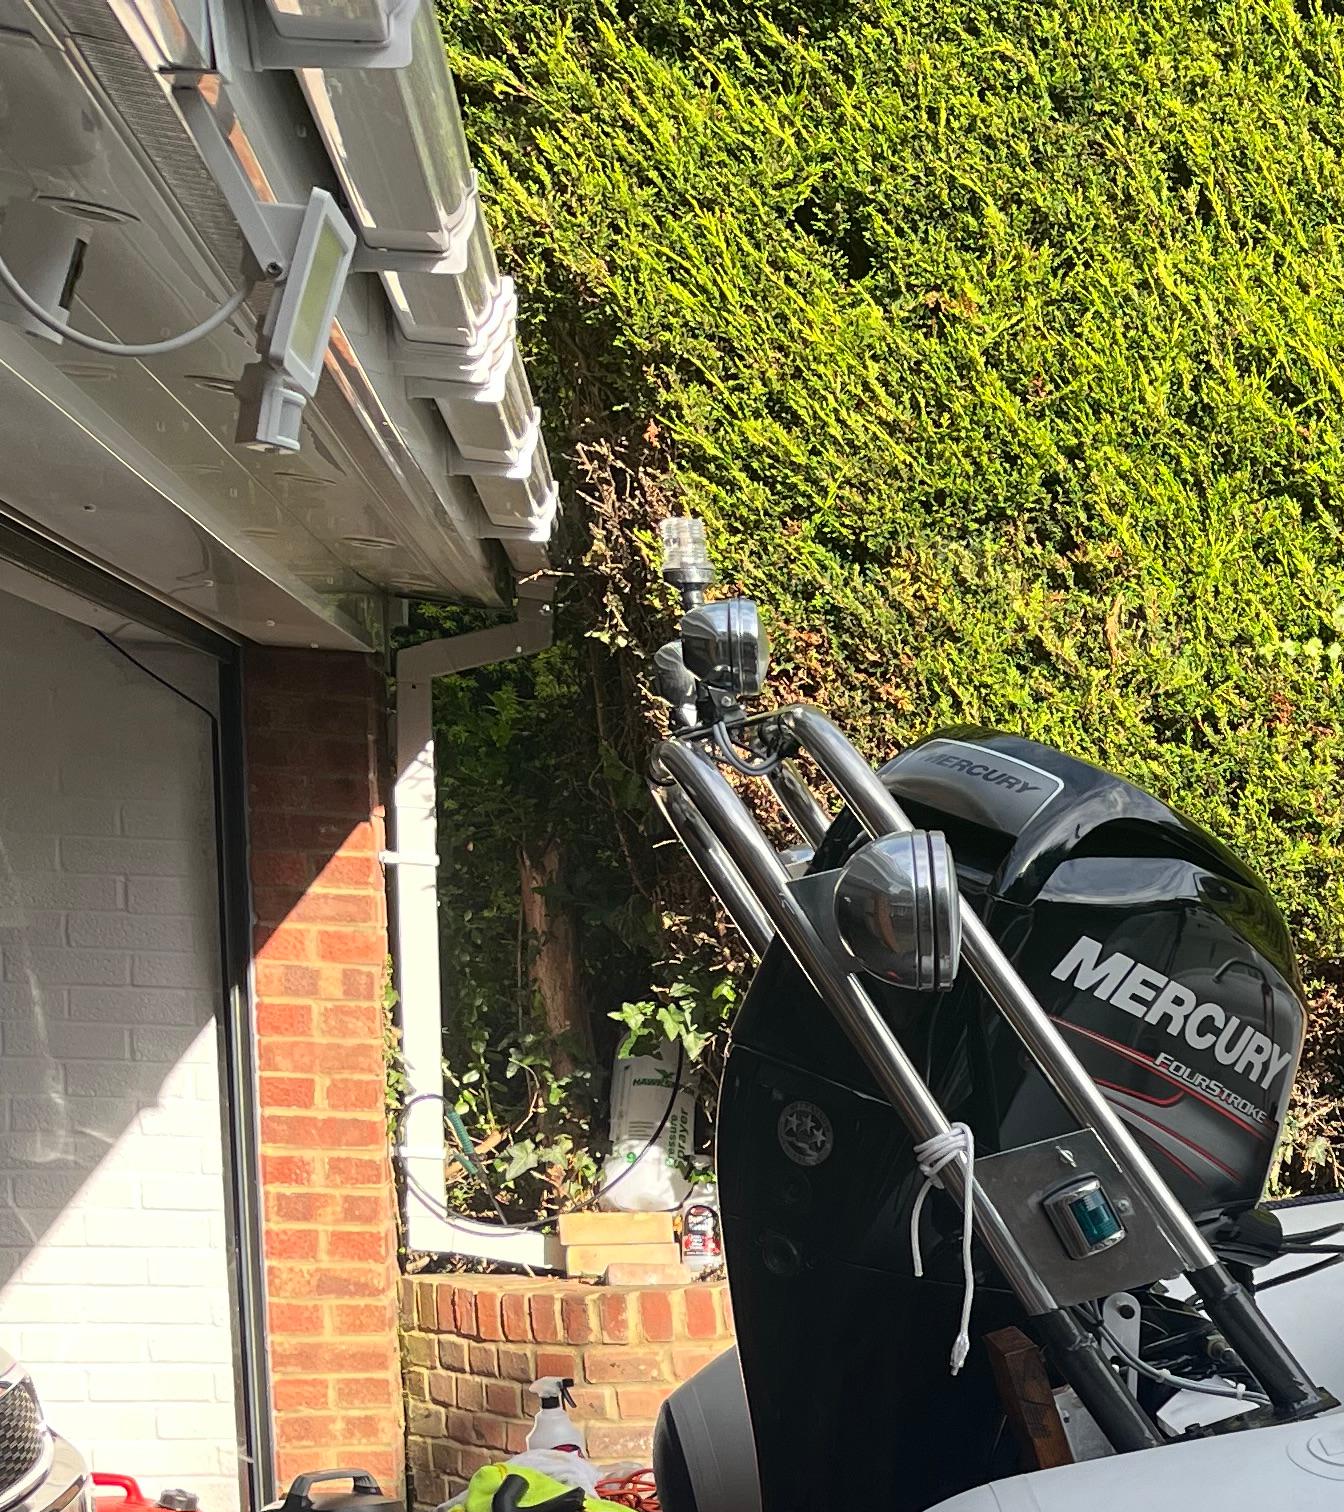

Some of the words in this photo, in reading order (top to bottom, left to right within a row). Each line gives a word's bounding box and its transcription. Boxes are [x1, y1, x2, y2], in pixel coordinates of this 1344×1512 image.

[921, 753, 1041, 794] MERCURY
[1050, 935, 1292, 1090] MERCURY
[674, 1109, 690, 1169] Sprayer
